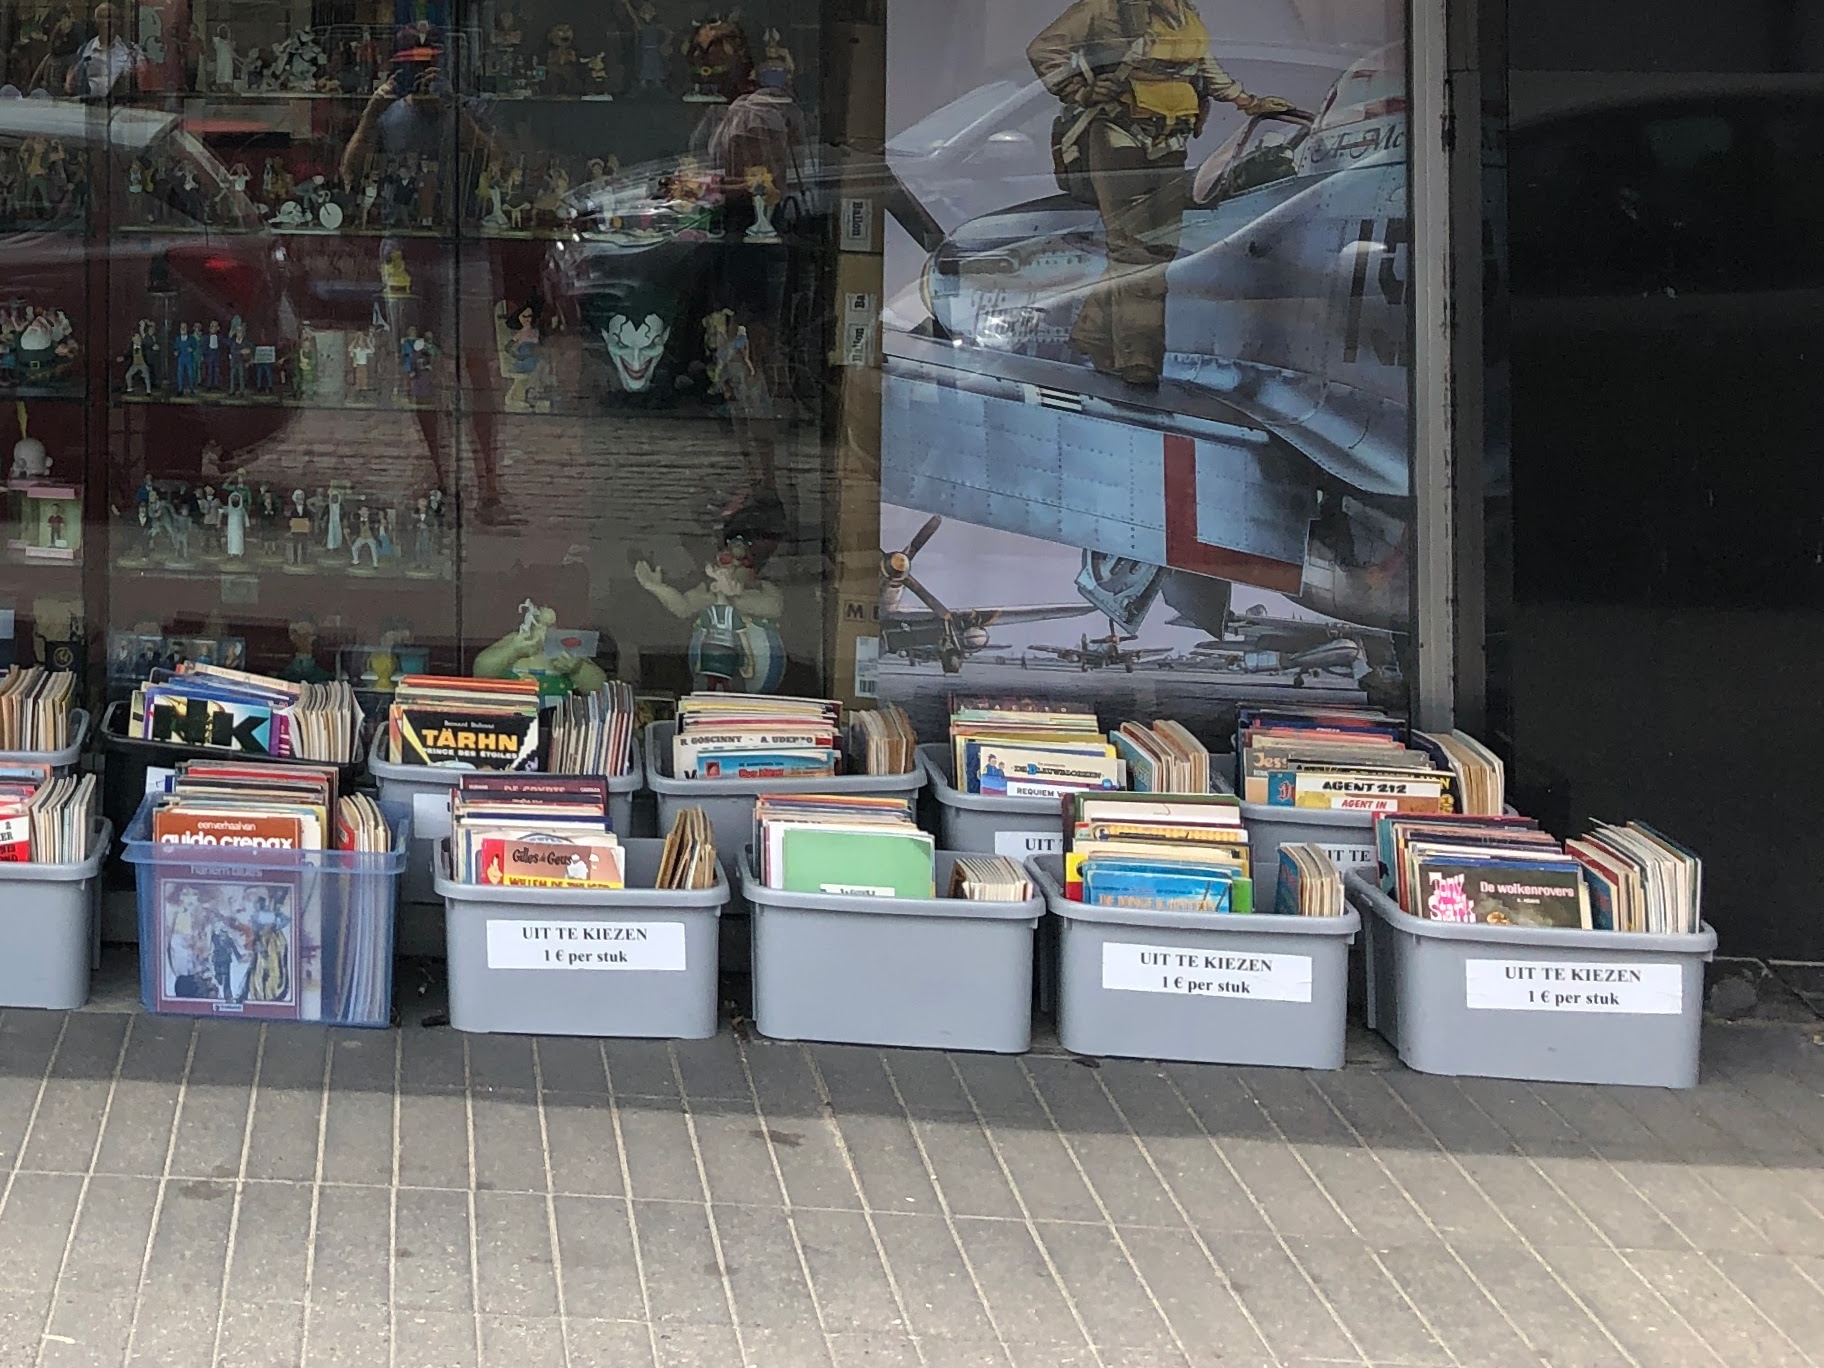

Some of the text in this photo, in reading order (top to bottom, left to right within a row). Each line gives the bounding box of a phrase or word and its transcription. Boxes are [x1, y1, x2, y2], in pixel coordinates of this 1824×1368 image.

[421, 728, 518, 751] TÄRHN
[691, 735, 743, 745] GOSCINNY
[1016, 786, 1055, 797] REQUIEM
[1322, 780, 1407, 794] AGENT 212
[1341, 799, 1388, 809] AGENT IN
[1025, 838, 1056, 851] UIT
[512, 846, 539, 864] Gilles
[547, 851, 572, 866] Geus
[1322, 849, 1372, 862] IT TE
[1428, 871, 1575, 898] Tony De wolkenrovers
[1428, 894, 1476, 923] Stark
[522, 926, 648, 941] UIT TE KIEZEN
[544, 950, 628, 965] 1 € per stuk
[1140, 951, 1273, 972] UIT TE KIEZEN
[1505, 966, 1642, 983] UIT TE KIEZEN
[1162, 976, 1251, 994] 1 € per stuk
[1528, 990, 1620, 1007] 1 € per stuk
